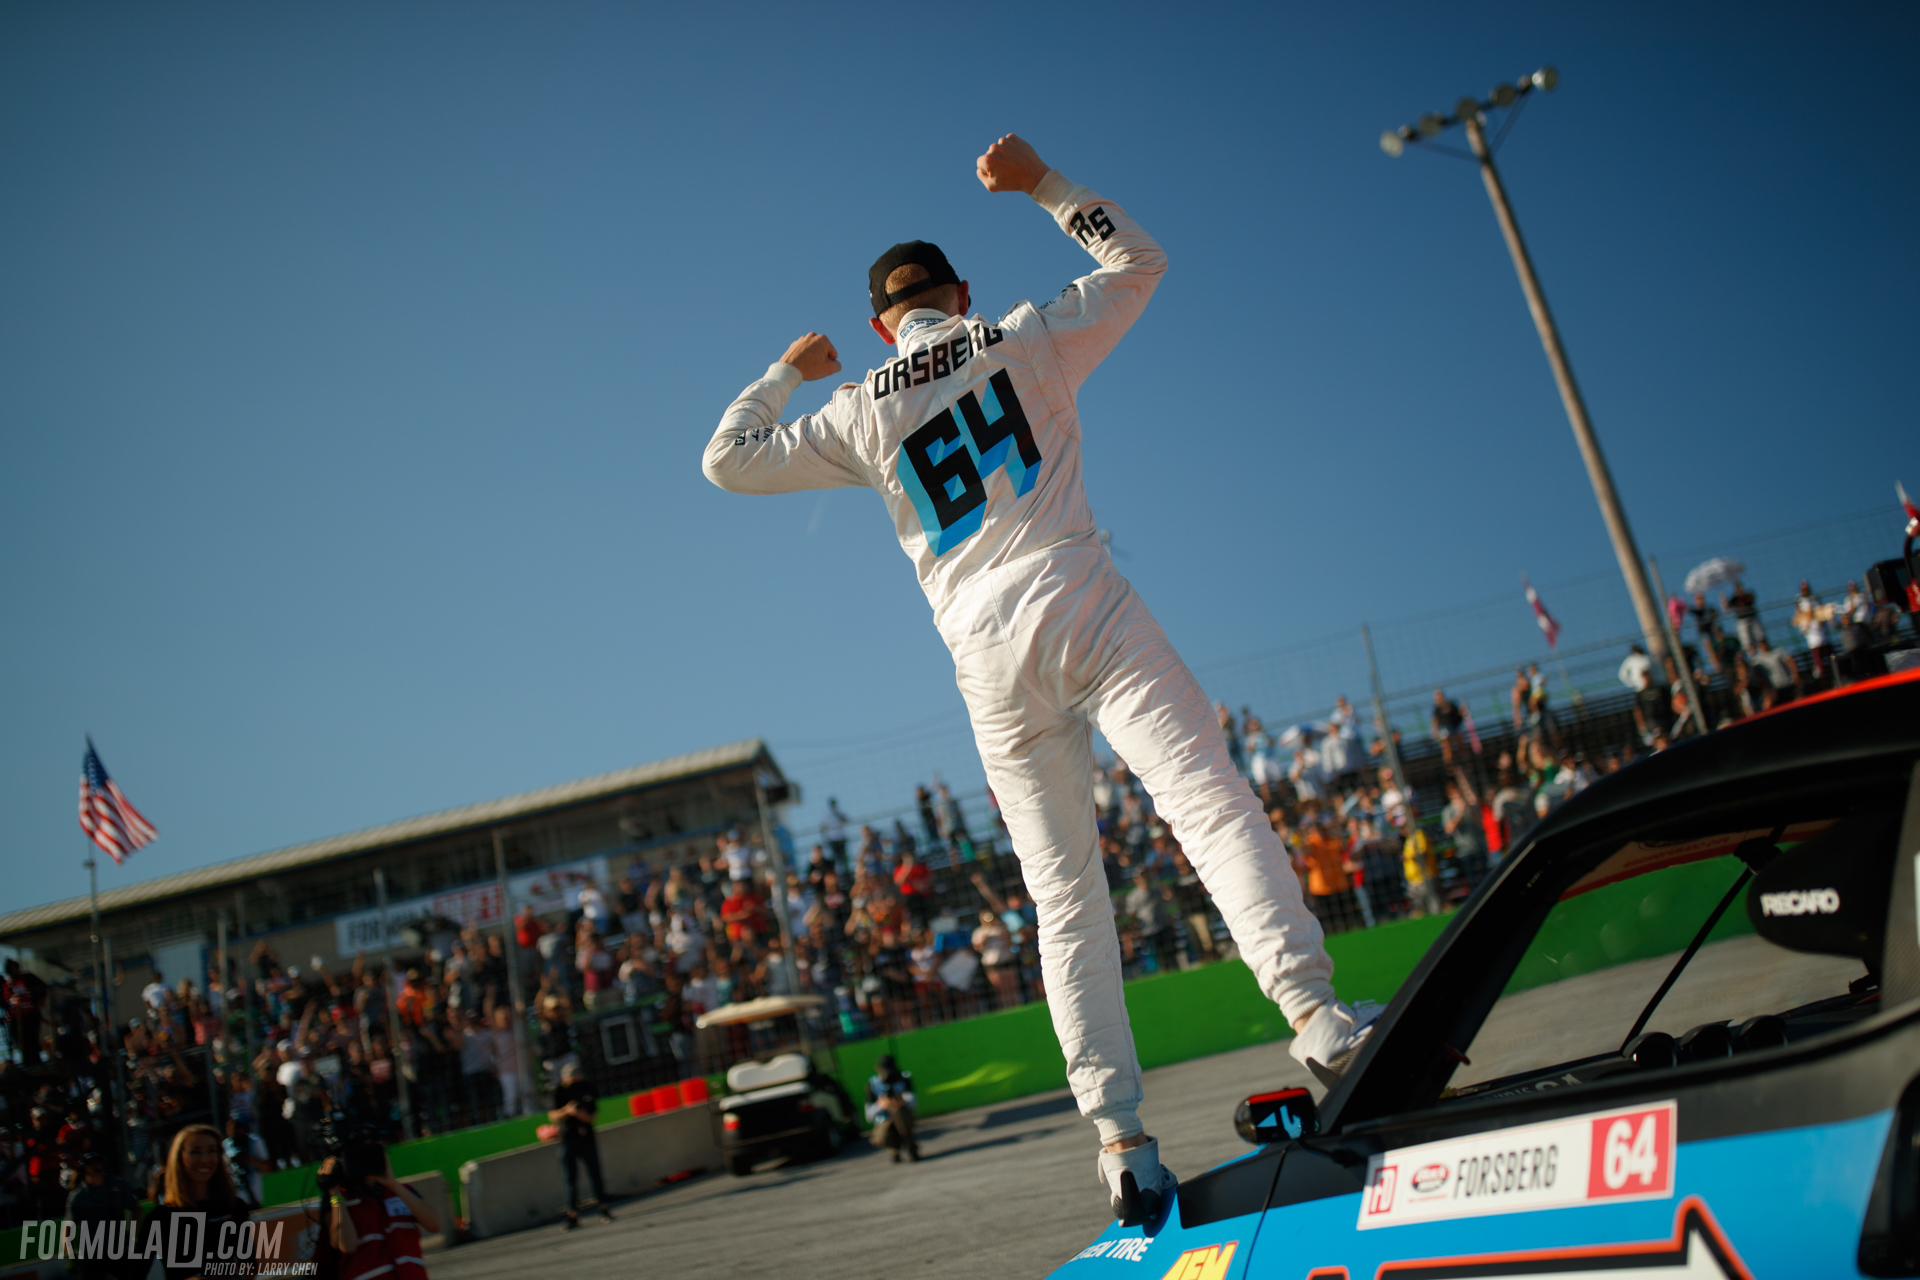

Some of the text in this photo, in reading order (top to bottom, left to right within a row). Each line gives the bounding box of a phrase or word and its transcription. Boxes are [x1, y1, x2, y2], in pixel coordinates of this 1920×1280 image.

[873, 322, 1004, 401] ORSBERG
[896, 367, 1042, 557] 64
[1760, 887, 1841, 917] RECARO
[1453, 1144, 1559, 1200] FORSBERG
[1602, 1113, 1659, 1190] 64
[1105, 1237, 1155, 1262] TIRE
